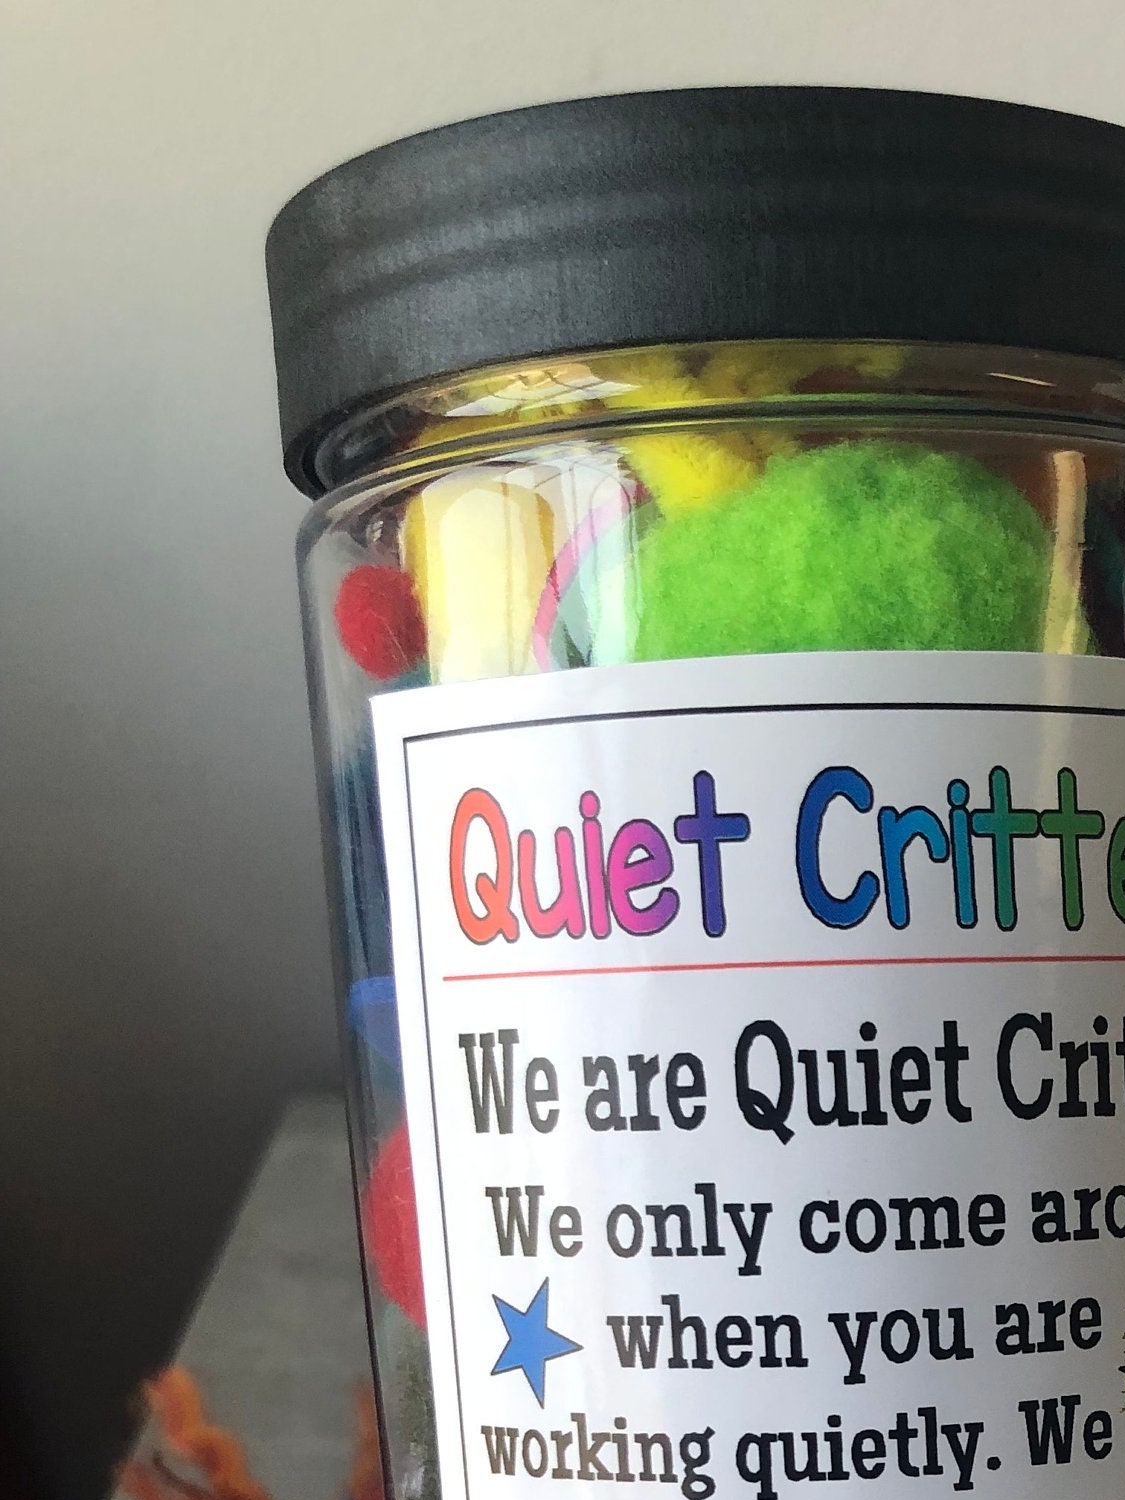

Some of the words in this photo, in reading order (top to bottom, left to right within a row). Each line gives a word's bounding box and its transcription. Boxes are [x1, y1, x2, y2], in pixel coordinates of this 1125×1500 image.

[449, 769, 751, 945] Quiet
[458, 1028, 560, 1135] We
[584, 1051, 707, 1132] are
[733, 1020, 972, 1145] Quiet
[485, 1184, 585, 1259] We
[605, 1182, 772, 1278] only
[798, 1192, 1008, 1252] come
[605, 1293, 808, 1373] when
[827, 1310, 974, 1385] you
[993, 1293, 1102, 1354] are
[480, 1413, 715, 1499] working
[735, 1410, 1002, 1500] quietly.
[1018, 1398, 1115, 1467] We
